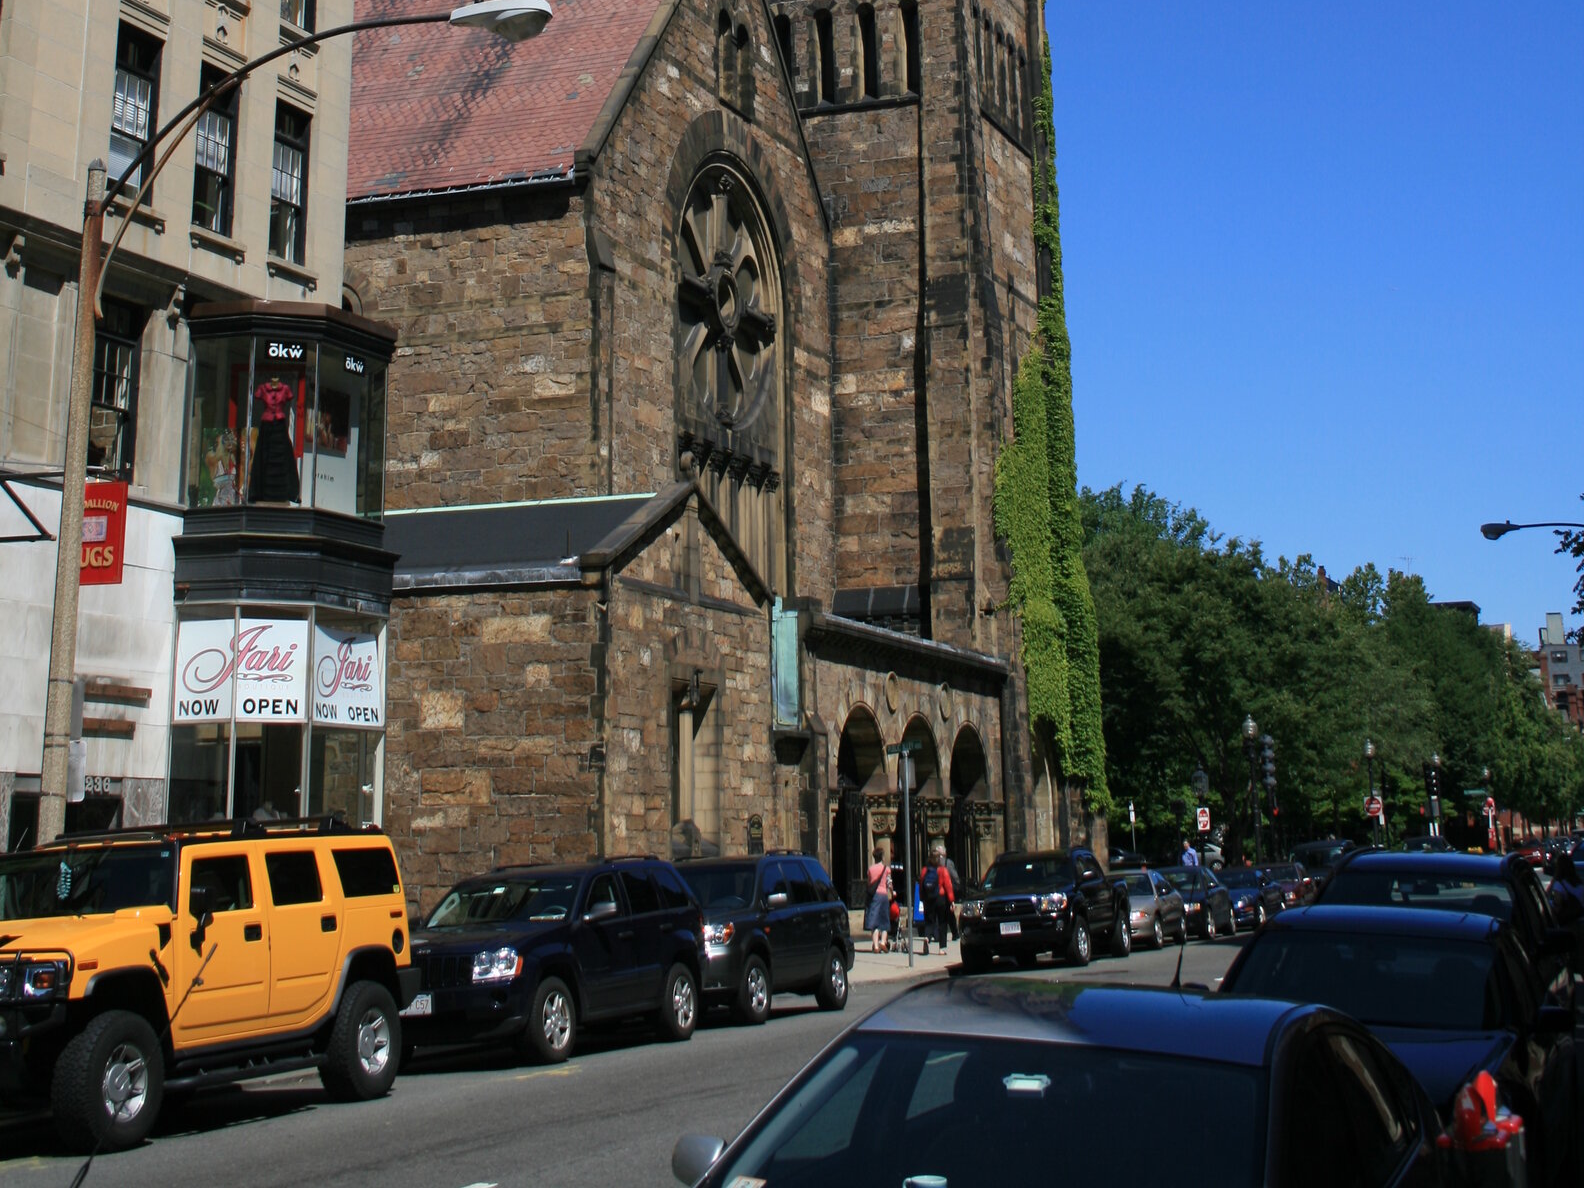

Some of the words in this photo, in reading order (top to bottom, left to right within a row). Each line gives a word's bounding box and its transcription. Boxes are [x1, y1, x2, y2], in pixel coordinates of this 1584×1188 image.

[80, 546, 114, 567] UGS
[182, 624, 298, 694] Jari
[179, 698, 219, 716] NOW
[243, 698, 298, 714] OPEN
[315, 702, 337, 719] NOW
[348, 706, 379, 722] OPEN
[85, 776, 110, 792] 236
